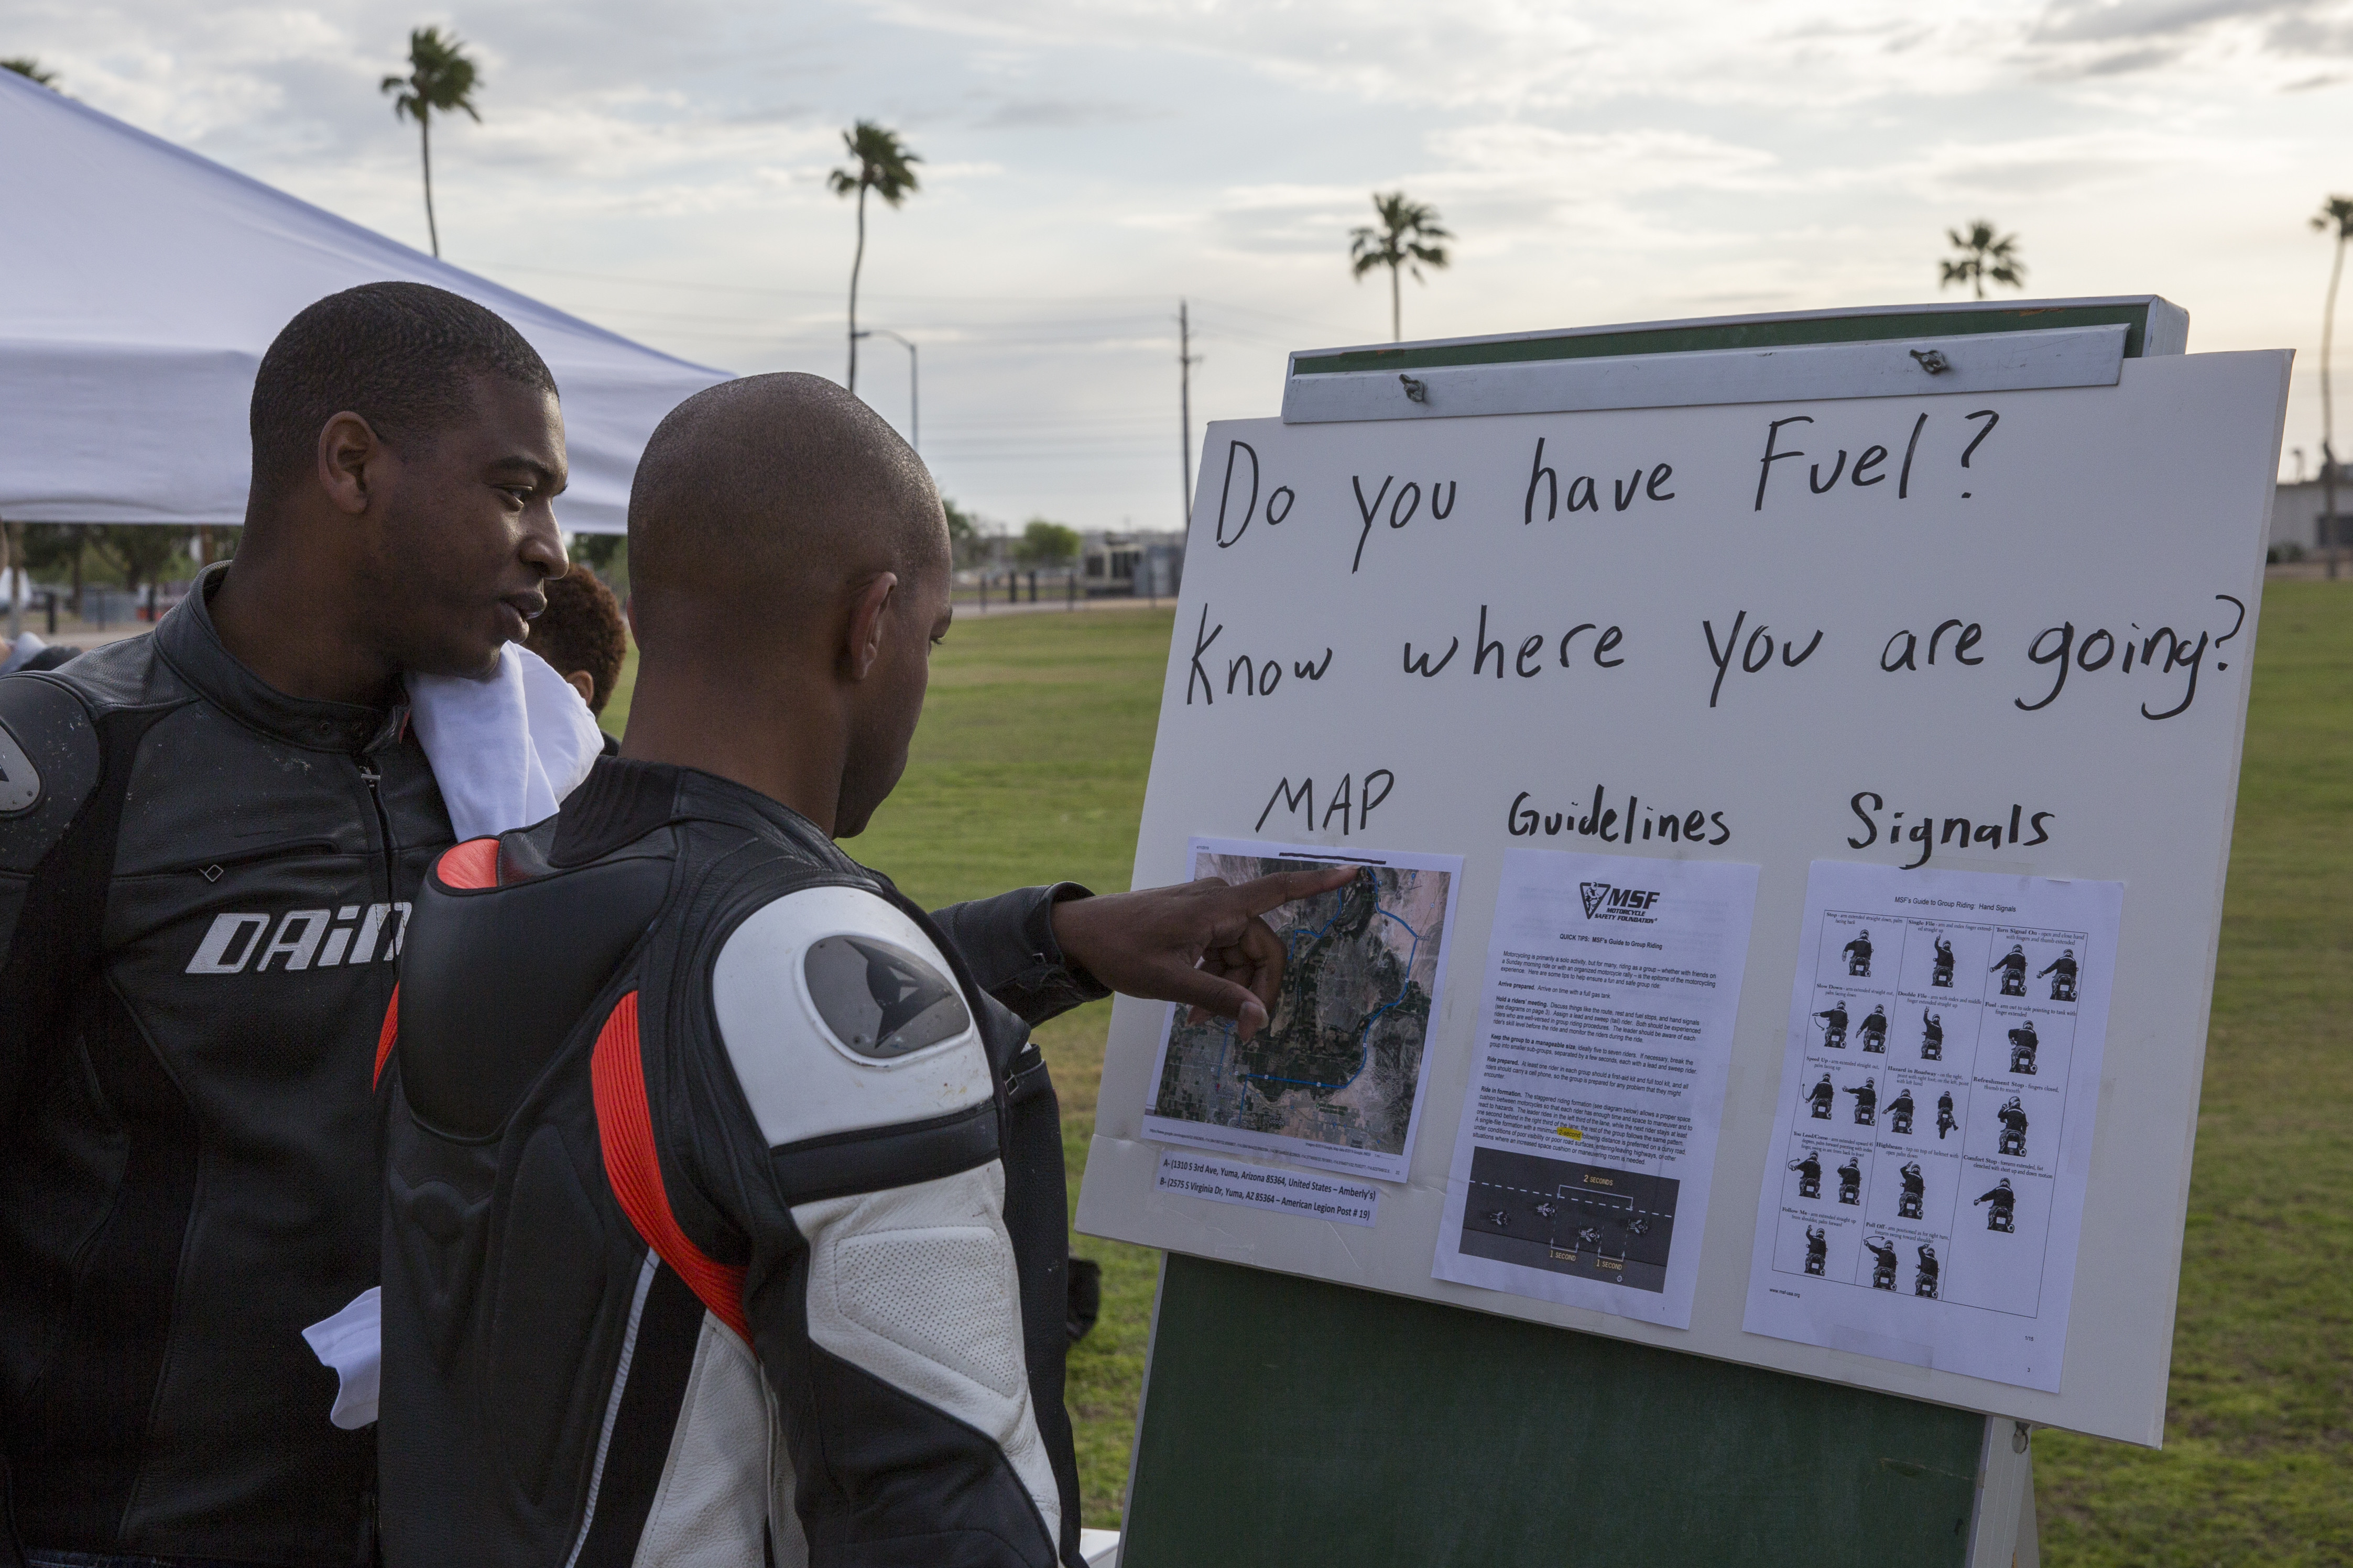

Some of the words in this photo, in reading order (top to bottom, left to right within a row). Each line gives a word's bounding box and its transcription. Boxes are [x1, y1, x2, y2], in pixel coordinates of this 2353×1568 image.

[1216, 440, 1295, 549] Do
[1352, 476, 1456, 574] you
[1525, 437, 1675, 525] have
[1187, 603, 1333, 705] Know
[1403, 605, 1624, 678] where
[1703, 610, 1823, 708] you
[1880, 619, 1984, 672] are
[2014, 595, 2245, 720] going?
[1255, 769, 1394, 836] MAP
[1508, 784, 1730, 846] Guidelines
[1847, 792, 2055, 870] Signals
[1607, 888, 1660, 909] MSF
[1937, 899, 1955, 908] Group
[1995, 904, 2016, 913] Signals
[1606, 907, 1646, 916] MOTORCYCLE
[1630, 940, 1646, 949] Group
[1646, 942, 1663, 950] Riding
[1503, 950, 1531, 960] Motorcycling
[1506, 958, 1523, 967] Sunday
[1684, 979, 1716, 988] motorcycling
[1527, 1000, 1548, 1008] meeting.
[1535, 1040, 1565, 1048] manageable
[1913, 1069, 1936, 1077] Roadway
[1973, 1076, 2009, 1085] Refreshment
[1497, 1088, 1522, 1097] formation.
[1802, 1132, 1828, 1141] Lead/Come
[1876, 1142, 1903, 1150] Highbeam
[1163, 1158, 1170, 1167] A-
[1171, 1159, 1188, 1170] (1310
[1193, 1163, 1204, 1172] 3rd
[1204, 1165, 1218, 1176] Ave,
[1221, 1167, 1239, 1179] Yuma,
[1240, 1171, 1265, 1182] Arizona
[1266, 1175, 1287, 1187] 85364,
[1288, 1178, 1311, 1189] United
[1311, 1181, 1332, 1193] States
[1589, 1177, 1614, 1186] SECONDS
[1160, 1177, 1167, 1185] B-
[1167, 1178, 1184, 1189] (2575
[1185, 1181, 1190, 1189] S
[1191, 1182, 1213, 1193] Virginia
[1214, 1186, 1223, 1197] Dr,
[1225, 1188, 1244, 1200] Yuma,
[1245, 1191, 1255, 1200] AZ
[1255, 1192, 1274, 1203] 85364
[1281, 1197, 1312, 1210] American
[1313, 1202, 1335, 1214] Legion
[1336, 1205, 1352, 1216] Post
[1353, 1208, 1358, 1217] #
[1358, 1210, 1370, 1221] 19)
[1555, 1252, 1576, 1261] SECOND
[1602, 1261, 1622, 1270] SECOND
[1769, 1288, 1800, 1298] www.msf-usa.org
